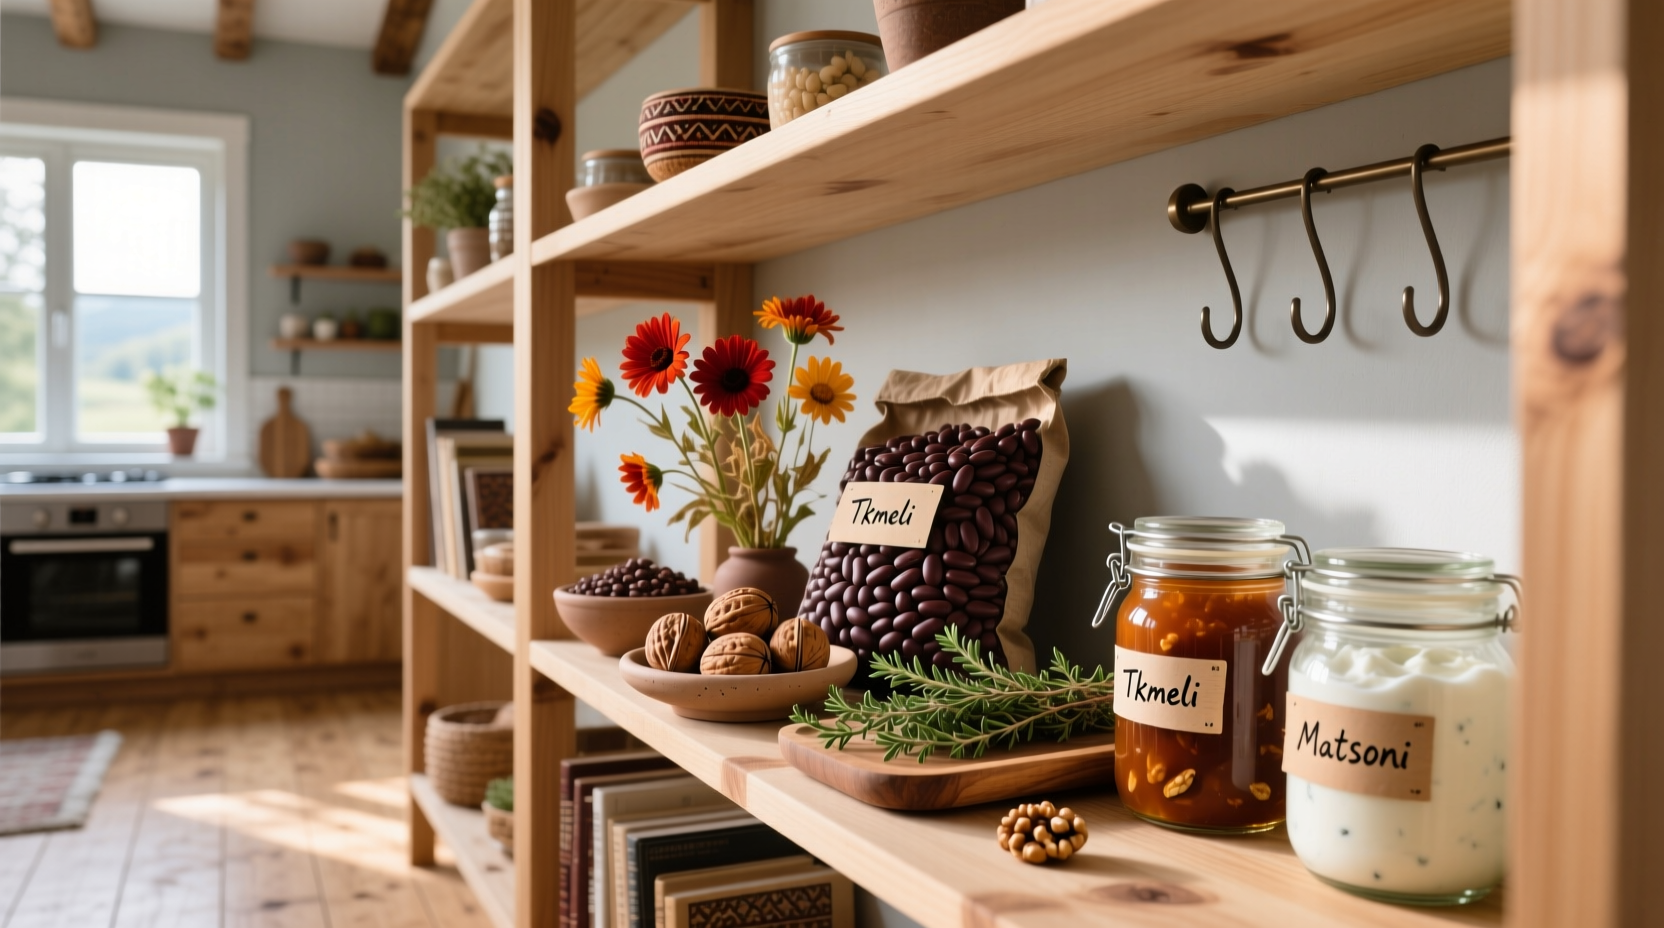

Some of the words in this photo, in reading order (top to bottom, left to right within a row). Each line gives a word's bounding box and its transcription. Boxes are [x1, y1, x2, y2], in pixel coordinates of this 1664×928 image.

[852, 498, 916, 525] Tkmeli
[1123, 669, 1200, 708] Tkmeli
[1297, 721, 1412, 770] Matsoni
